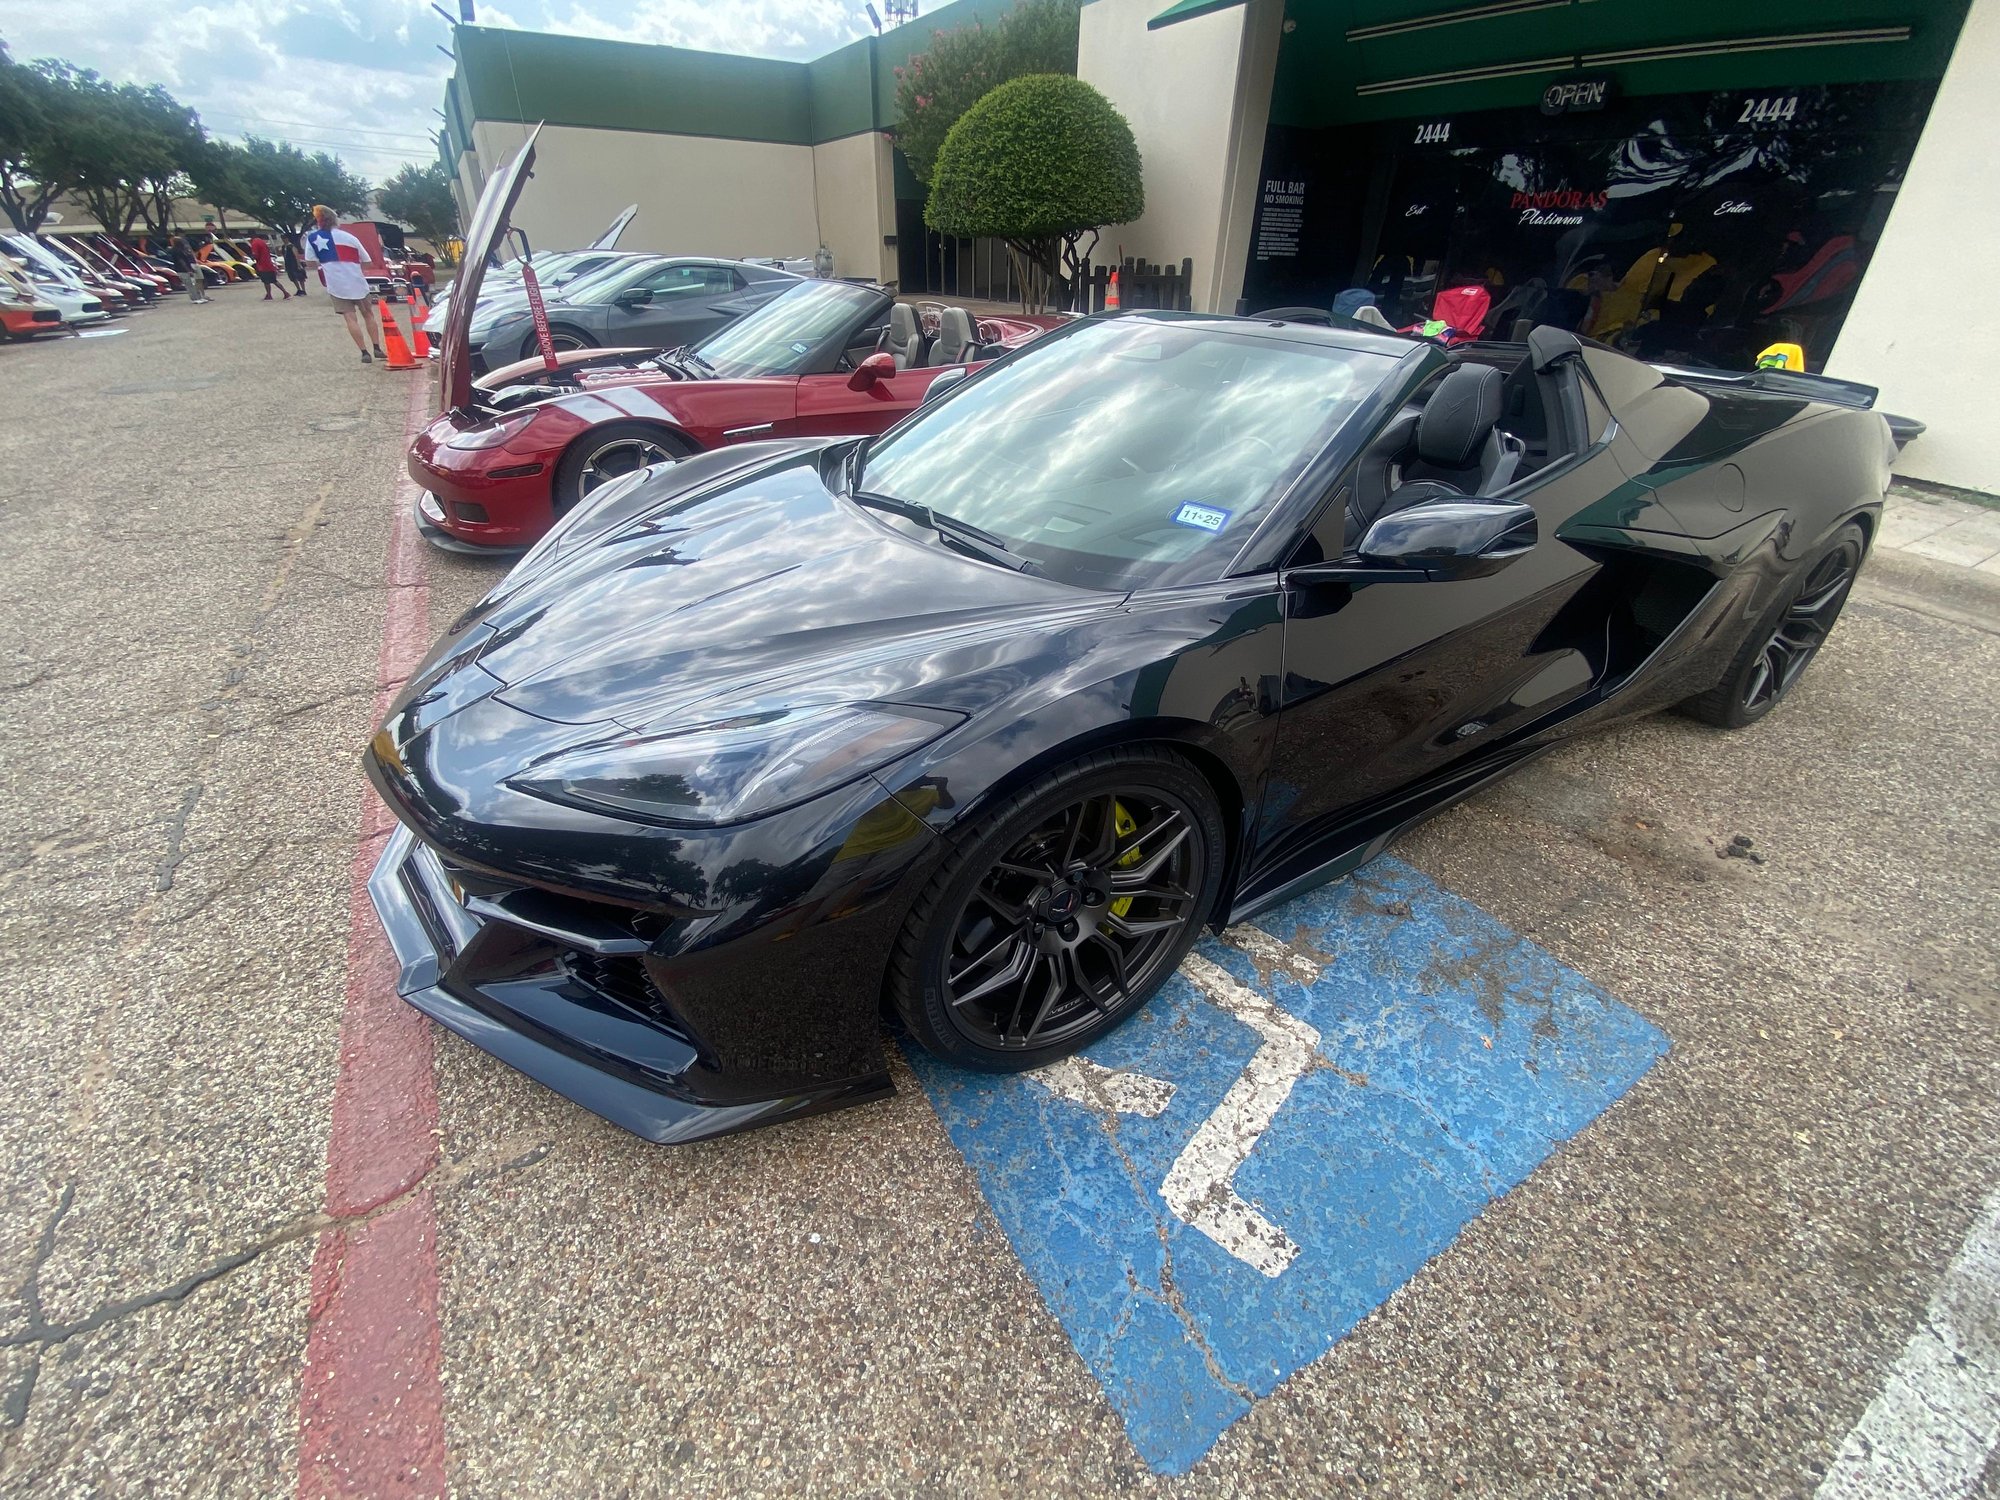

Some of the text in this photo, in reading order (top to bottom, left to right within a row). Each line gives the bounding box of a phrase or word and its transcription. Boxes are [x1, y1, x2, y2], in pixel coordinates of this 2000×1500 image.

[1545, 81, 1606, 108] OPEN
[1737, 96, 1798, 123] 2444
[1414, 122, 1450, 144] 2444
[1265, 180, 1305, 194] FULL BAR
[1264, 194, 1304, 205] NO SMOKING
[1510, 191, 1609, 210] PANDORAS
[1713, 200, 1753, 216] Enter
[1517, 208, 1584, 226] Platinum
[527, 281, 554, 359] REMOVE BEFORE FLIGHT
